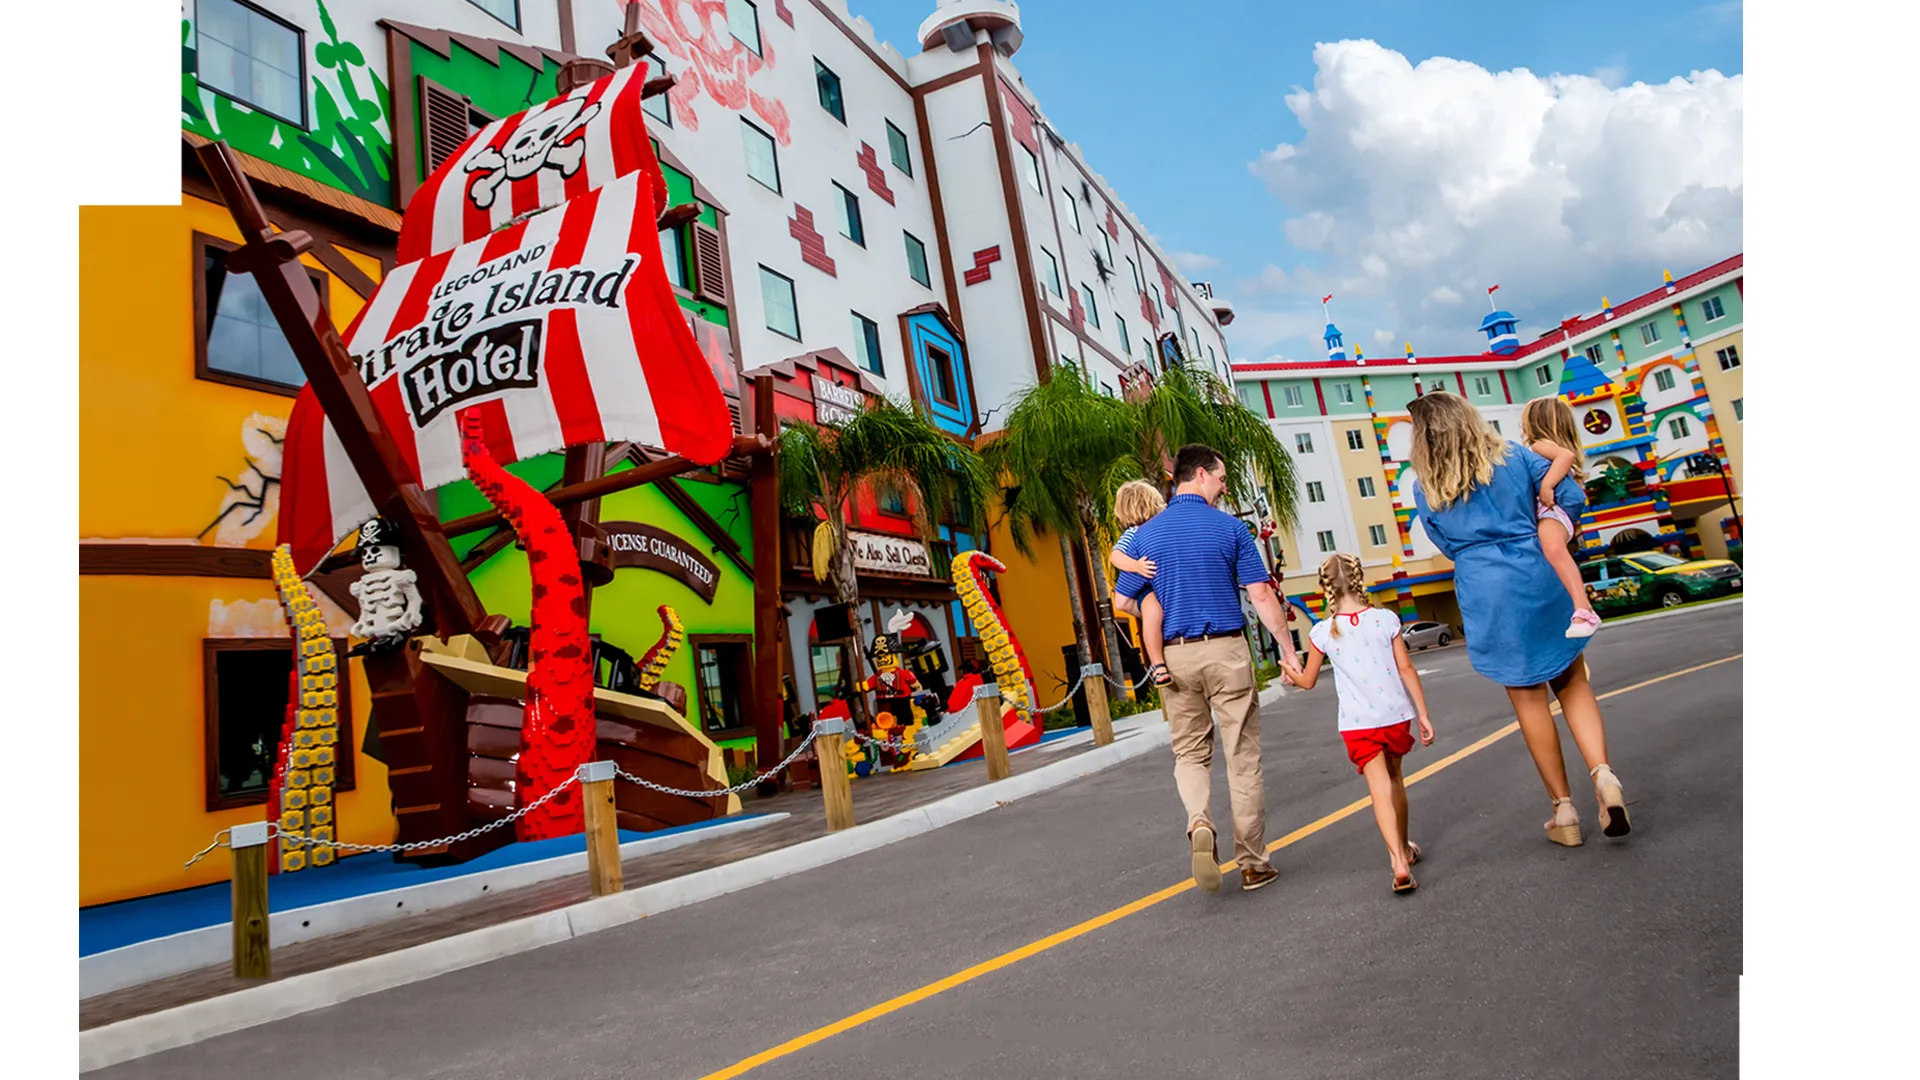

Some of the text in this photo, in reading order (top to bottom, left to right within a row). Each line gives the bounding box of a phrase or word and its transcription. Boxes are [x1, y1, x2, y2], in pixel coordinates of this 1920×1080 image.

[434, 244, 546, 300] LEGOLAND
[477, 258, 635, 324] Island
[410, 324, 535, 416] Hotel
[650, 538, 714, 587] GUARANTEED!
[866, 541, 883, 561] Also
[885, 544, 901, 563] Sell
